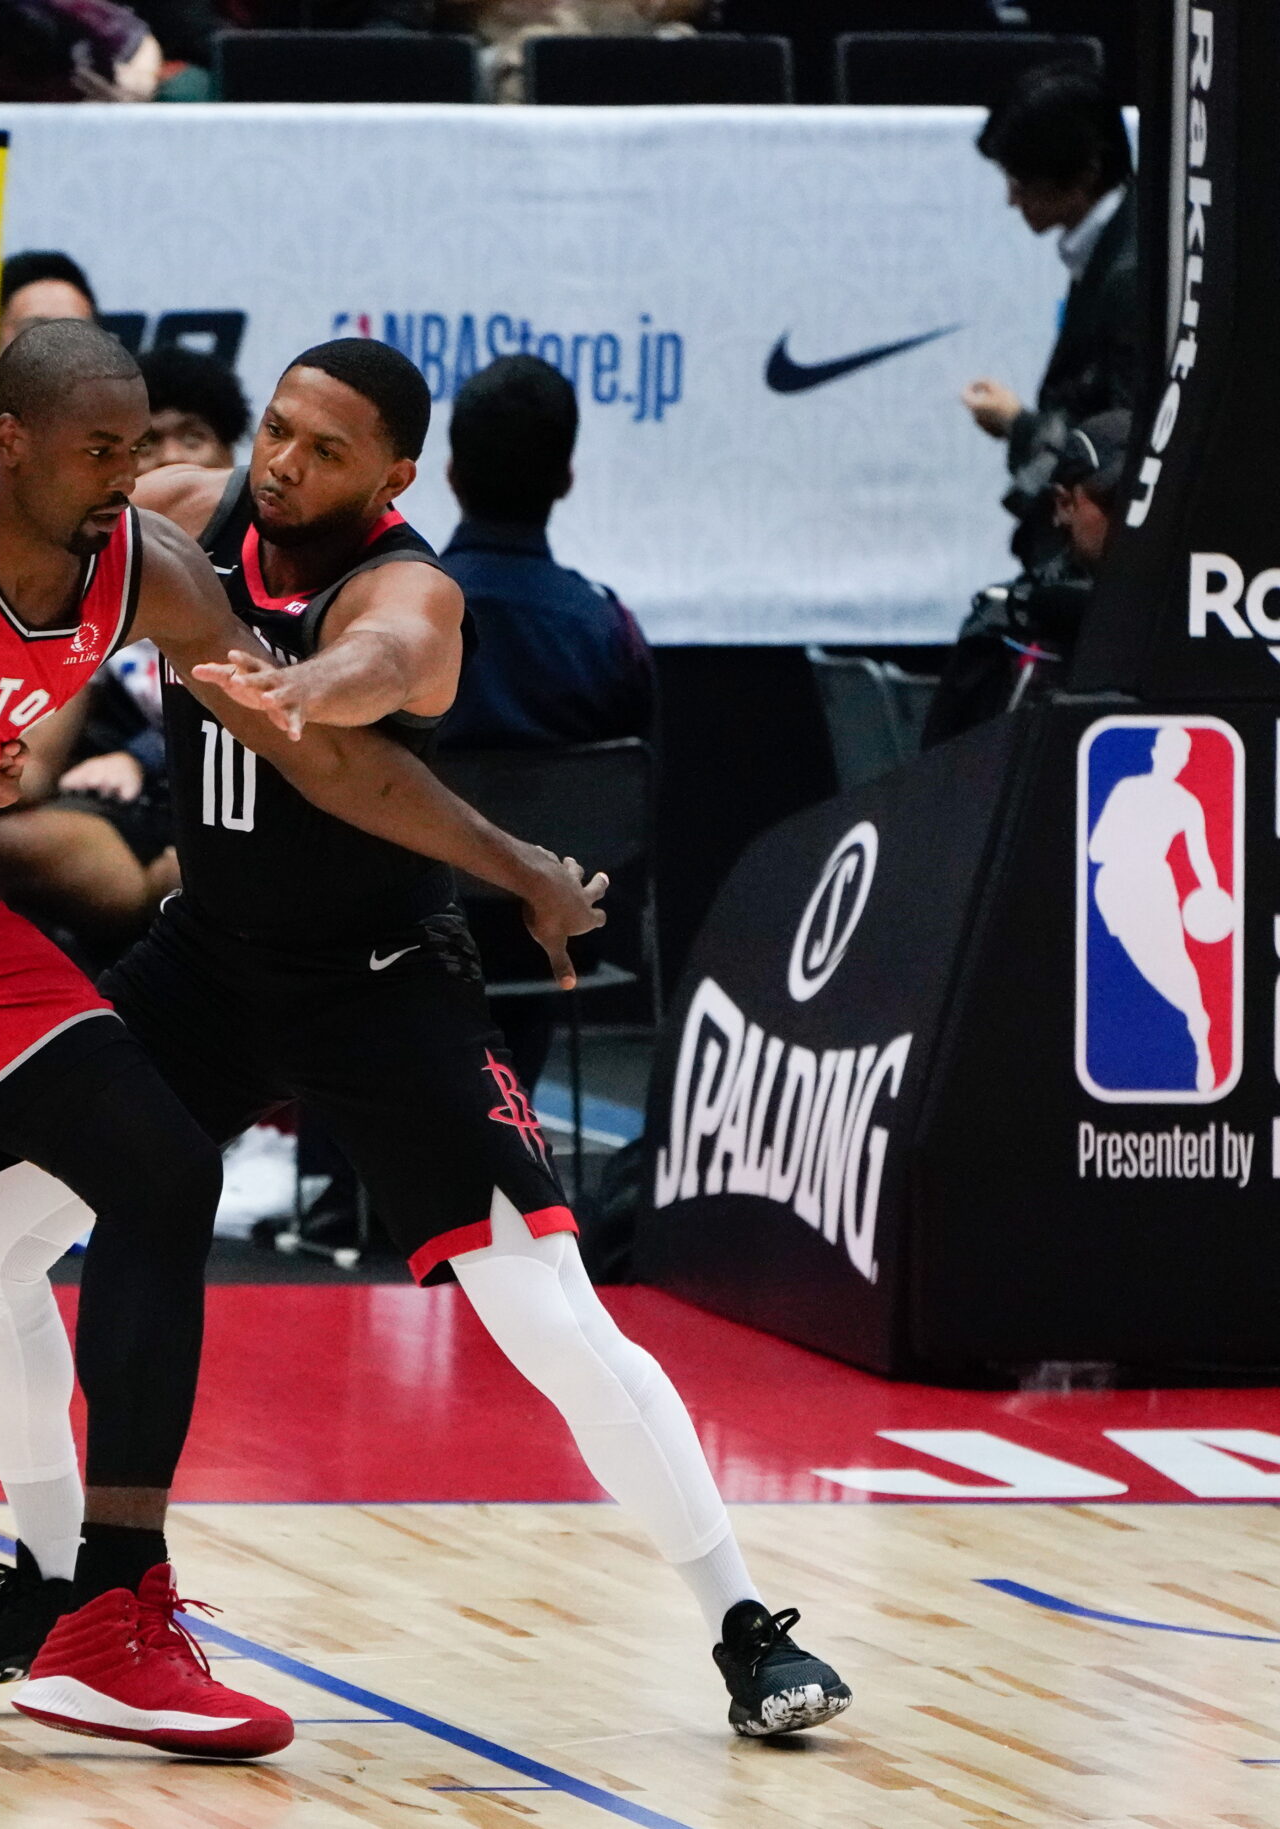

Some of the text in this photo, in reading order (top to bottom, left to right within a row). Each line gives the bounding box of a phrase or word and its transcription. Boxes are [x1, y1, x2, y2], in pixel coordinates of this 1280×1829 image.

[1126, 6, 1214, 528] Rakuten
[79, 651, 100, 663] Life
[200, 719, 257, 833] 10
[654, 976, 913, 1284] SPALDING
[1078, 1120, 1217, 1179] Presented
[1222, 1120, 1256, 1189] by
